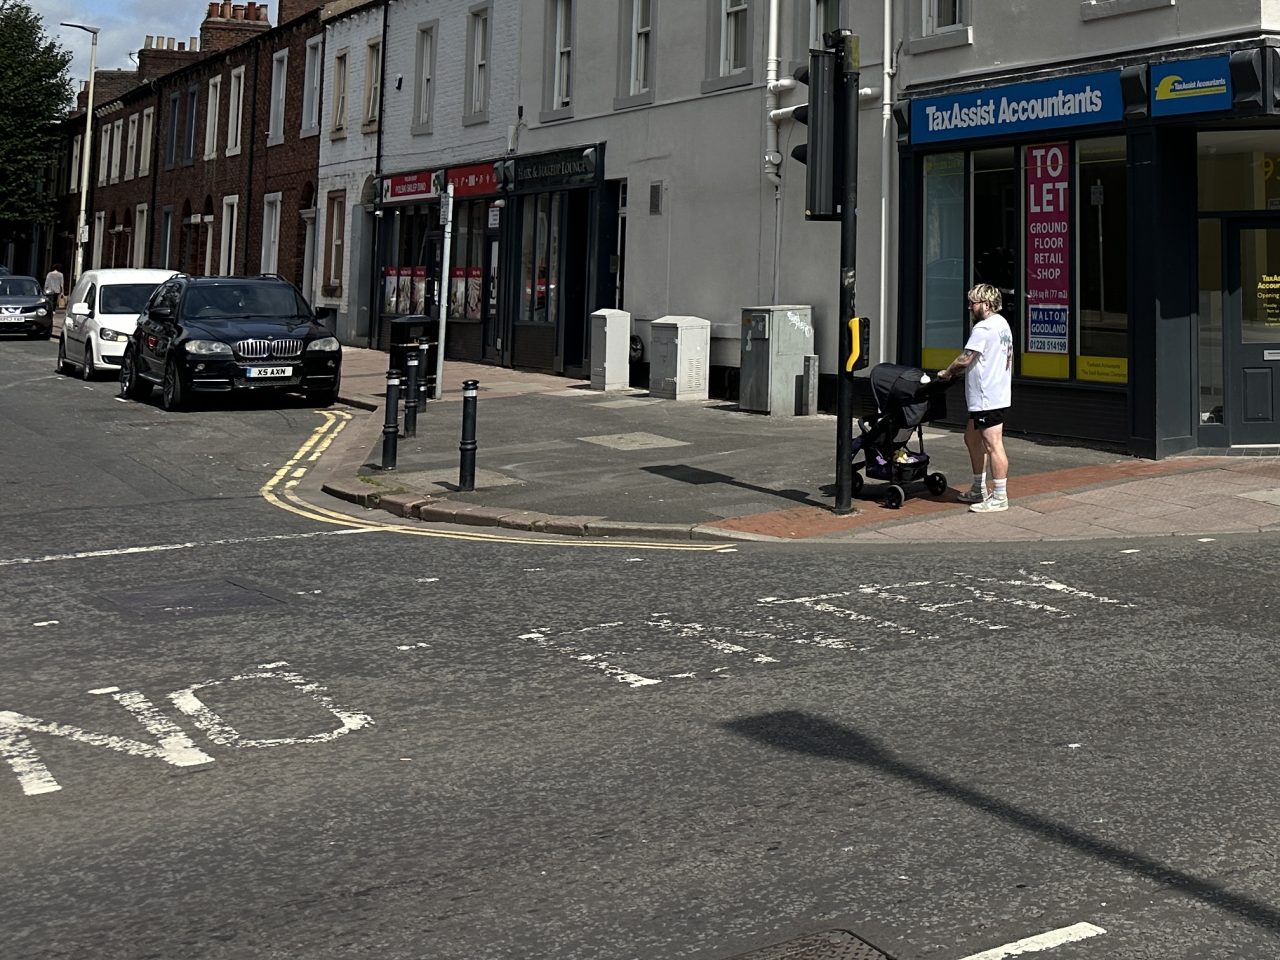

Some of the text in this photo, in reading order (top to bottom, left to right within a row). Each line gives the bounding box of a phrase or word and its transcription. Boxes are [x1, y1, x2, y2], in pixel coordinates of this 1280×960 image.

[926, 86, 1102, 131] TaxAssist Accountants
[1032, 147, 1063, 178] TO
[1030, 182, 1068, 213] LET
[1030, 222, 1068, 234] GROUND
[1034, 237, 1064, 249] FLOOR
[1034, 253, 1064, 264] RETAIL
[1037, 268, 1061, 280] SHOP
[1031, 310, 1066, 321] WALTON
[1031, 323, 1066, 333] GOODLAND
[1030, 340, 1067, 351] 01228 514199
[270, 368, 286, 376] AXN
[0, 671, 376, 796] NO
